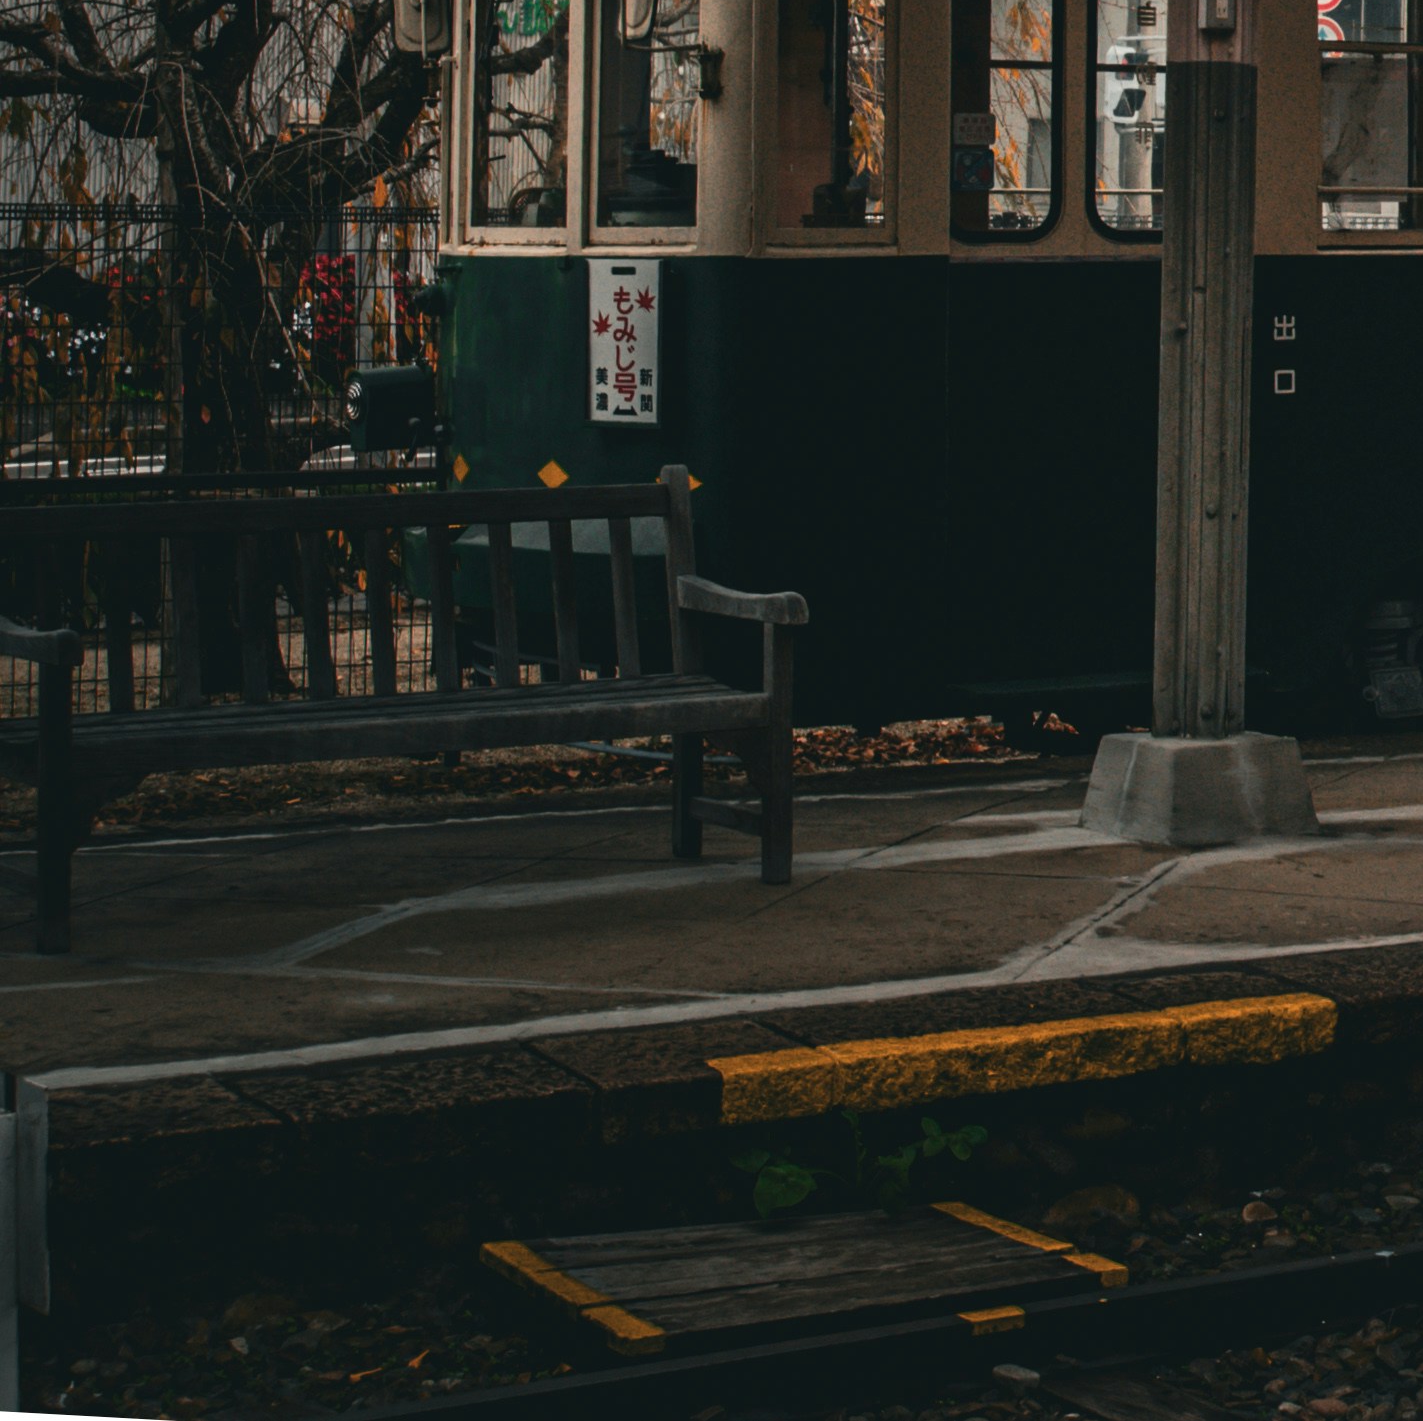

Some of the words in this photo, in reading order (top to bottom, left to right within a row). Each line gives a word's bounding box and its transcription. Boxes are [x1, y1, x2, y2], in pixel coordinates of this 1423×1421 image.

[613, 286, 637, 402] もみじ号
[1273, 313, 1297, 395] 出口
[596, 367, 609, 411] 美濃
[640, 368, 653, 412] 新関
